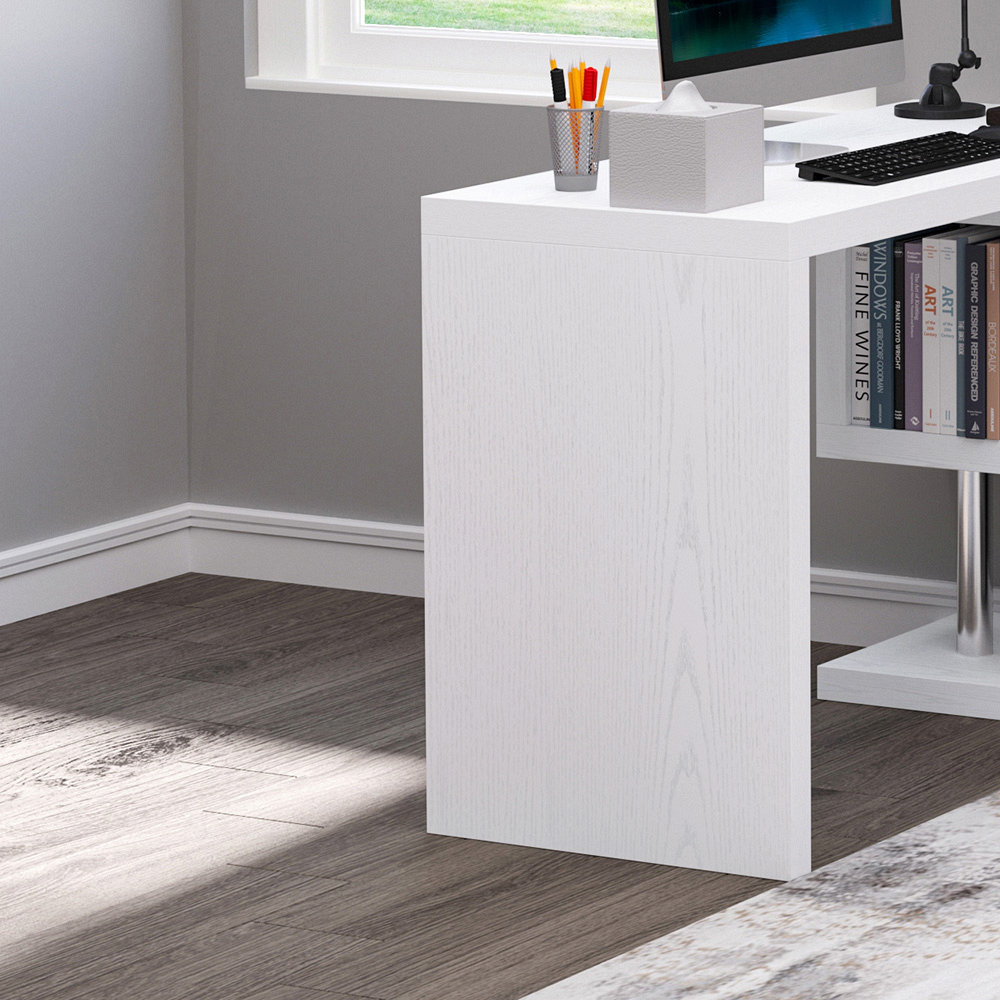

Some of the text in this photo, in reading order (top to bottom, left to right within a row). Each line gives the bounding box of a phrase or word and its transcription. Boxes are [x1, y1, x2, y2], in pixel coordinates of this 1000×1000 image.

[855, 271, 869, 319] FINE
[873, 241, 887, 320] WINDOWS
[924, 284, 936, 316] ART
[942, 286, 954, 317] ART
[970, 261, 979, 303] GRAPHIC
[970, 305, 979, 339] DESIGN
[855, 330, 869, 401] WINES
[987, 321, 997, 373] BORDEAUX
[970, 341, 979, 402] REFERENCED
